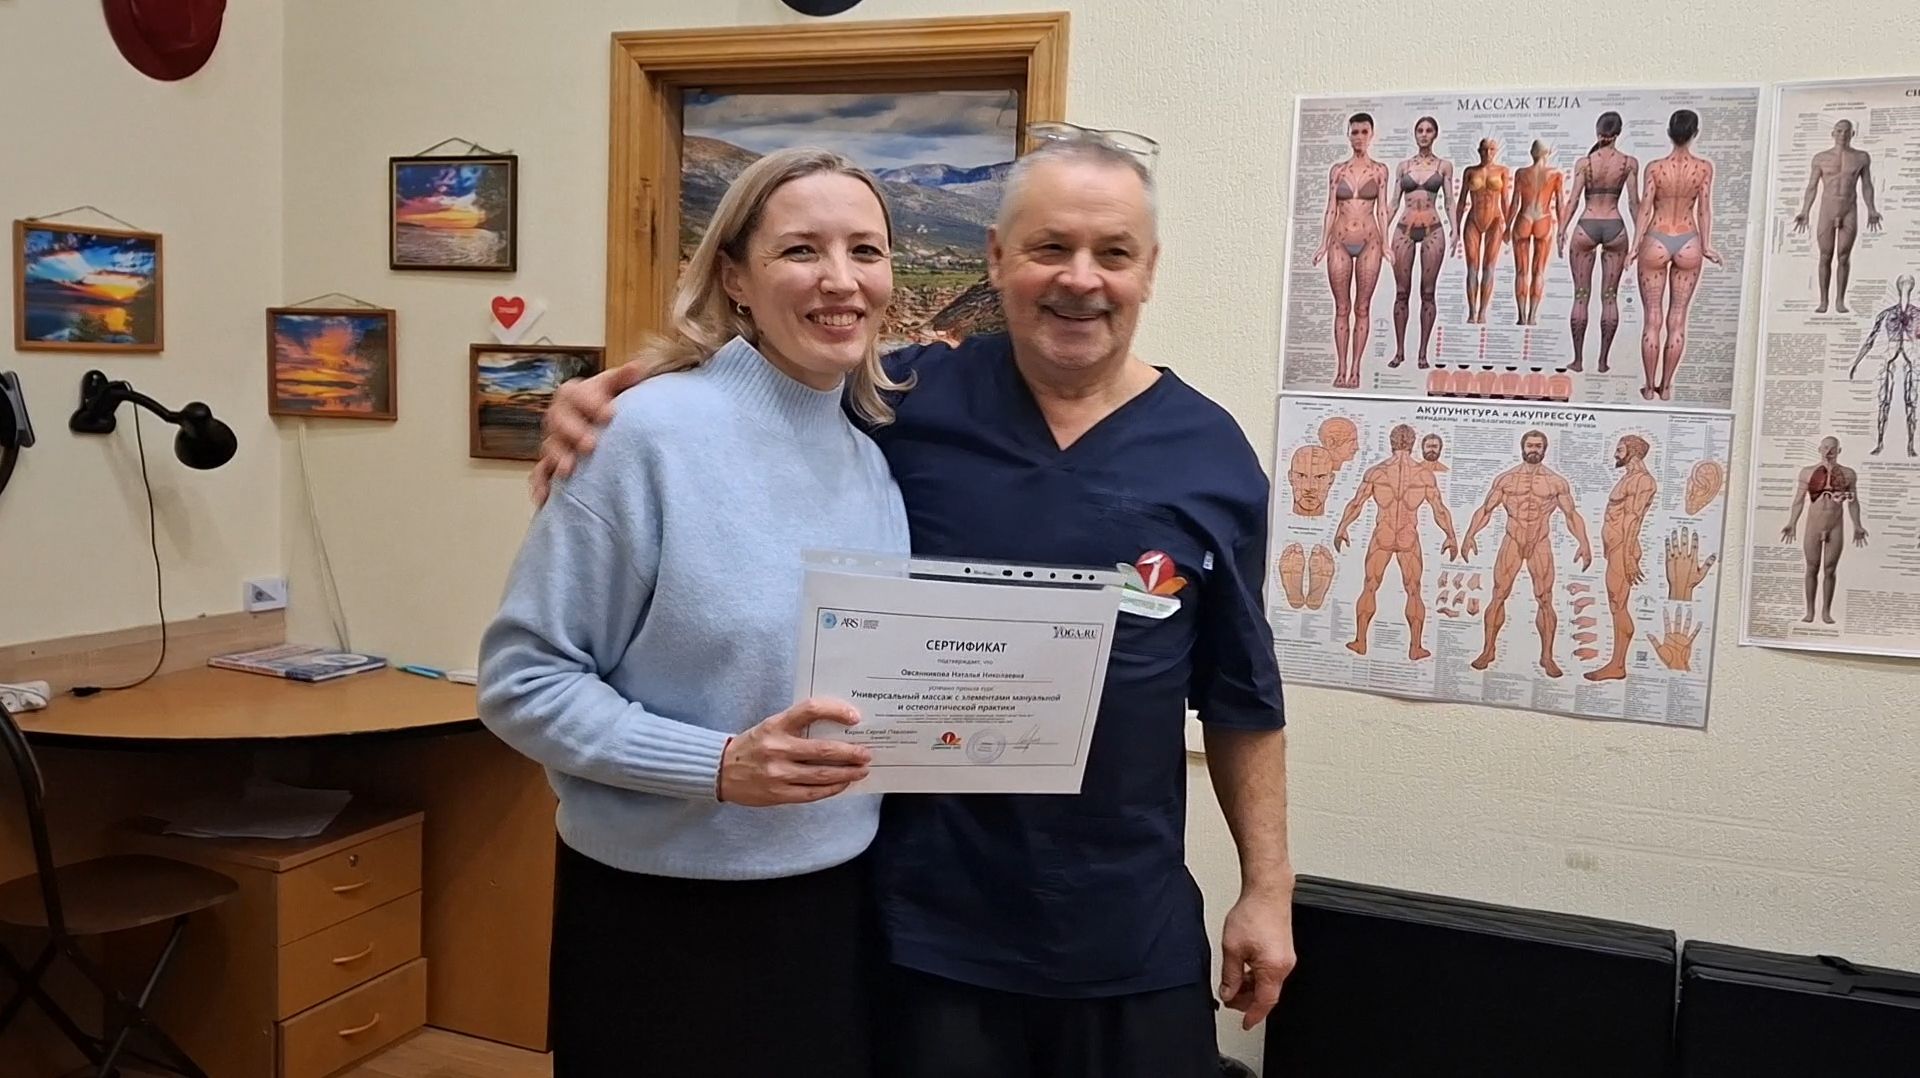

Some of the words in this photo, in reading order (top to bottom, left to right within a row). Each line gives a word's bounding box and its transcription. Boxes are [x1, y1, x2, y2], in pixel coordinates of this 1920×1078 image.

[1457, 96, 1531, 111] МАССАЖ
[1535, 95, 1581, 109] ТЕЛА
[1416, 405, 1500, 418] АКУПУНКТУРА
[1512, 409, 1597, 422] АКУПРЕССУРА
[926, 639, 1008, 653] СЕРТИФИКАТ
[851, 689, 920, 701] Универсальный
[921, 693, 953, 701] массаж
[1011, 694, 1062, 703] мануальной
[905, 703, 977, 712] остеопатической
[978, 704, 1016, 713] практики
